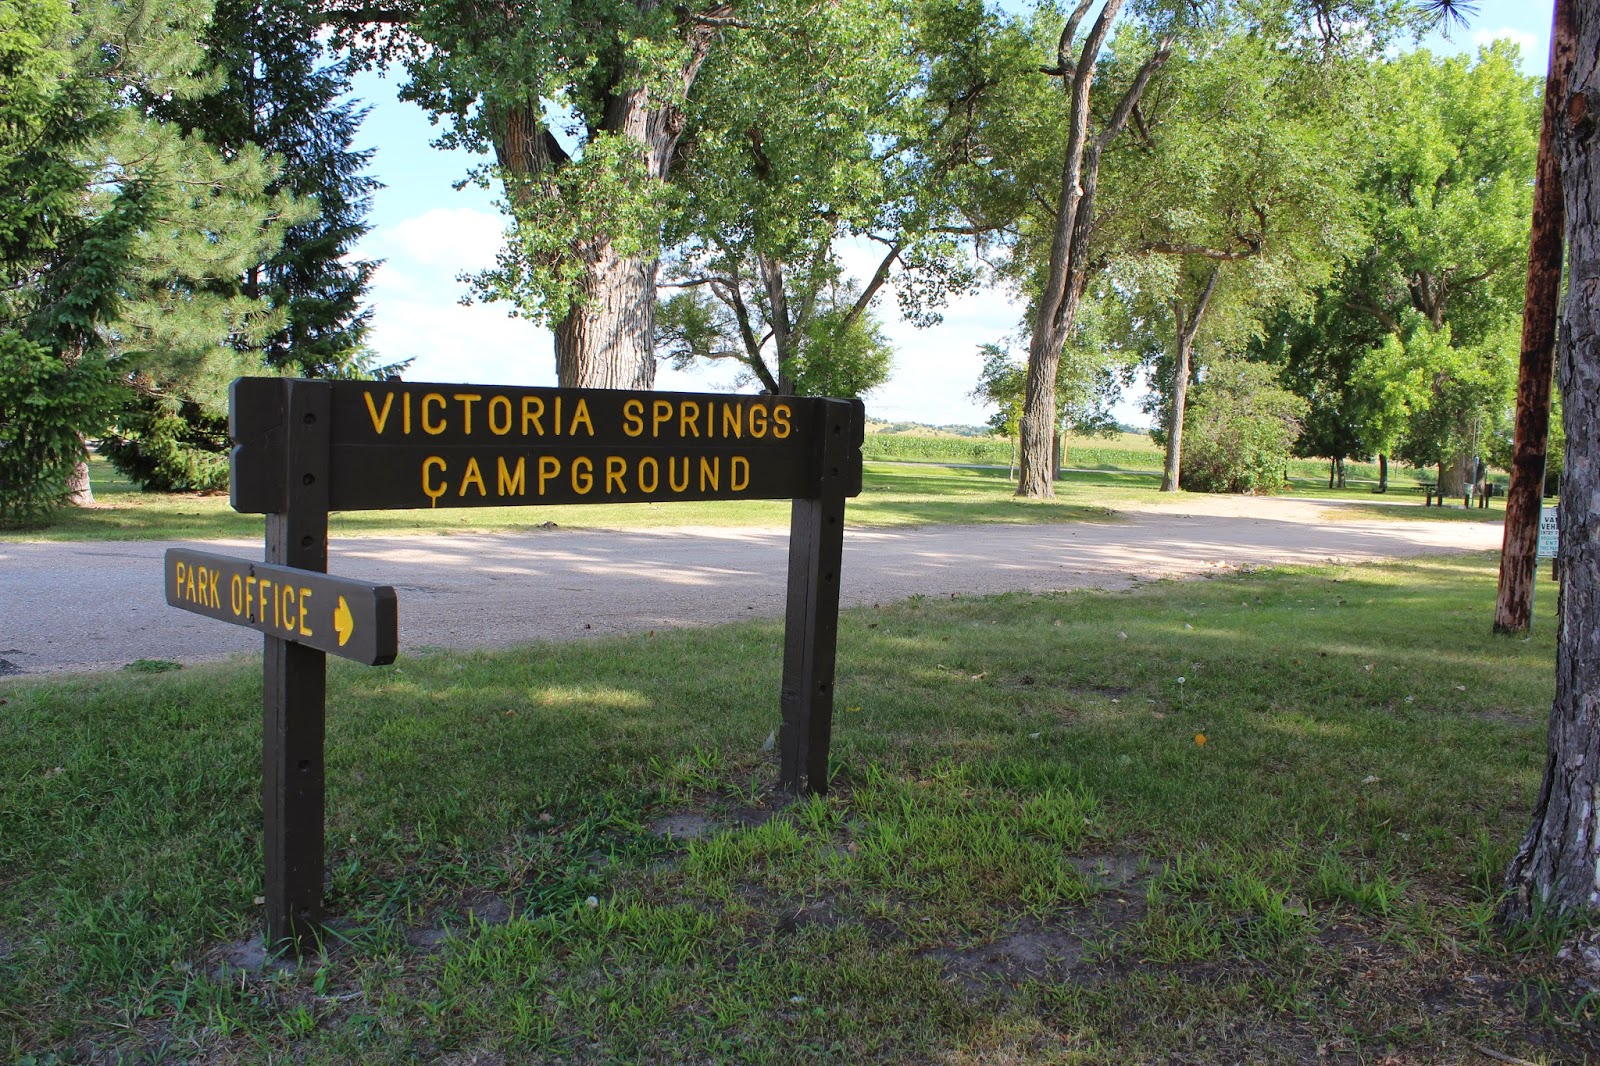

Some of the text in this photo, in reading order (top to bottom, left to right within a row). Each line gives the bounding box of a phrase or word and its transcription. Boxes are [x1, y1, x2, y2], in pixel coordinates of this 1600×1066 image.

[363, 391, 792, 439] VICTORIA SPRINGS
[421, 456, 751, 499] CAMPGROUND
[175, 560, 313, 637] PARK OFFICE
